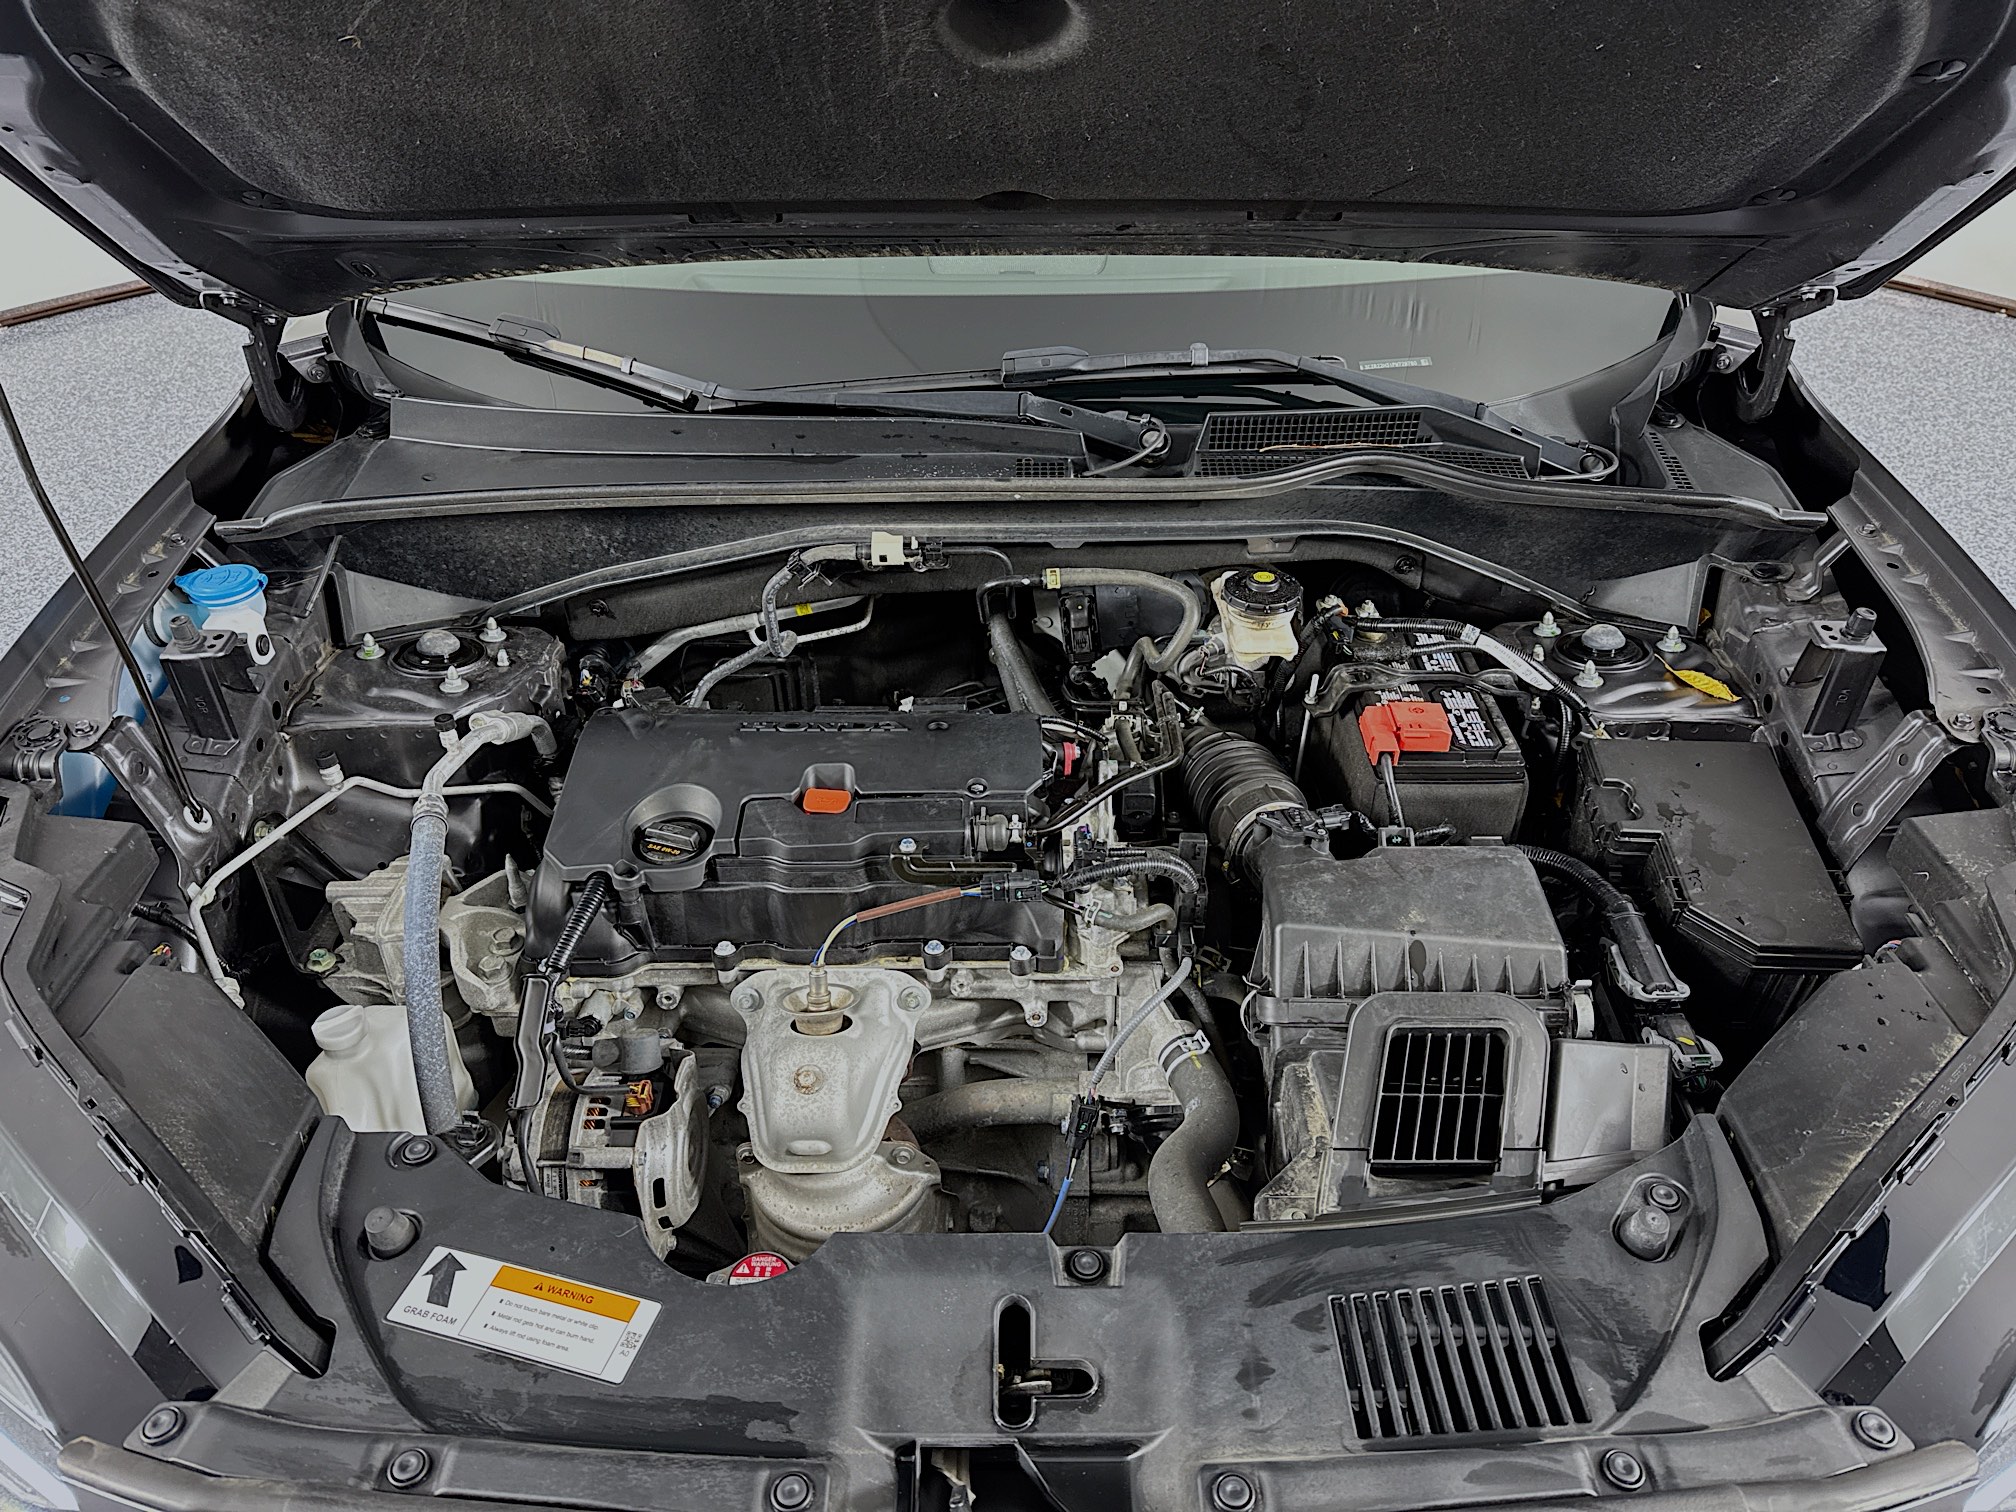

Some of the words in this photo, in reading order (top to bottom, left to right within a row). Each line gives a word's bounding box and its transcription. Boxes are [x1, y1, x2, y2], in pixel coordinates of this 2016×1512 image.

[739, 721, 909, 732] HONDA
[647, 843, 661, 851] SAE
[547, 1284, 594, 1304] WARNING
[403, 1305, 430, 1318] GRAB
[430, 1312, 458, 1326] FOAM
[497, 1312, 512, 1321] Metal
[513, 1316, 522, 1324] rod
[522, 1319, 534, 1327] gets
[535, 1322, 544, 1330] hot
[544, 1325, 556, 1333] and
[555, 1328, 566, 1336] can
[523, 1304, 538, 1313] touch
[538, 1308, 551, 1317] bare
[552, 1312, 567, 1322] metal
[573, 1318, 588, 1328] white
[489, 1325, 508, 1336] Always
[517, 1332, 526, 1340] rod
[526, 1335, 542, 1345] using
[541, 1339, 556, 1348] foam
